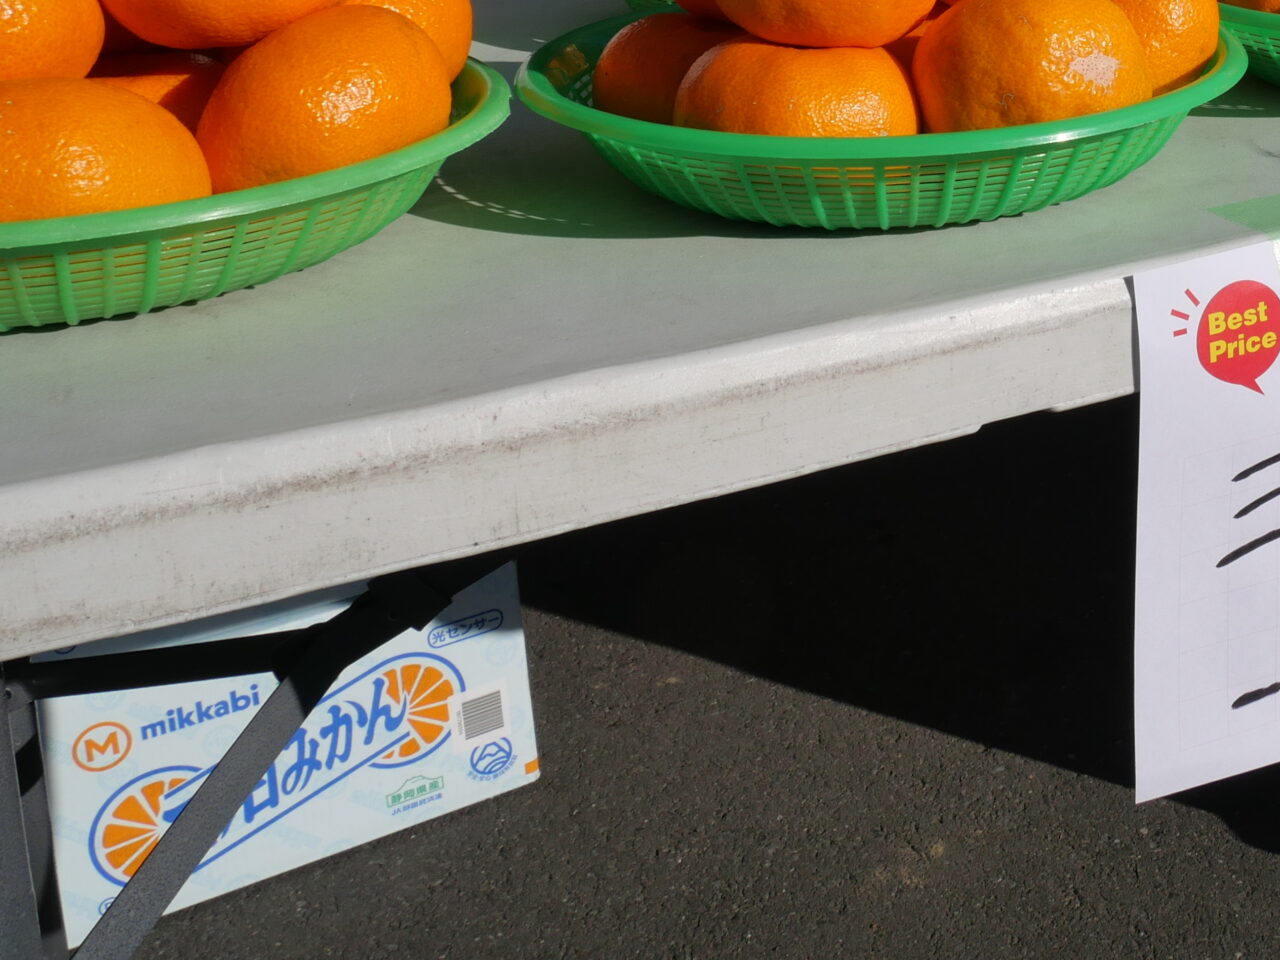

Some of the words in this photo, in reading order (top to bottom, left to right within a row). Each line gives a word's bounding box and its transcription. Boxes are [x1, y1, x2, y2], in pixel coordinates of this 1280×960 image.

[1207, 301, 1269, 335] Best
[1208, 330, 1278, 364] Price
[432, 616, 500, 643] 光センサー
[140, 685, 261, 740] mikkabi
